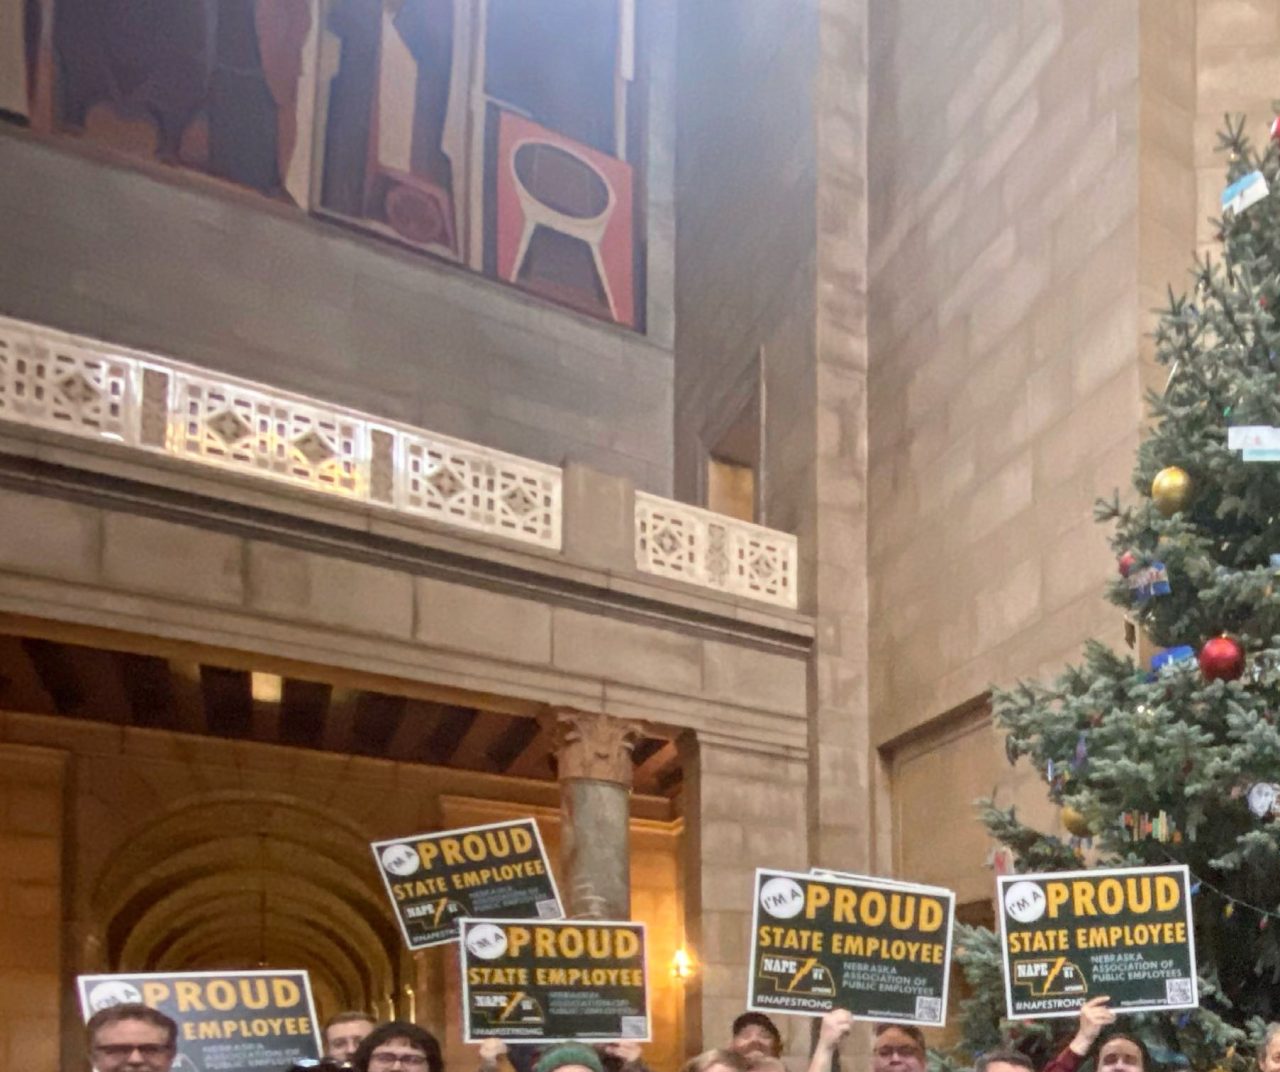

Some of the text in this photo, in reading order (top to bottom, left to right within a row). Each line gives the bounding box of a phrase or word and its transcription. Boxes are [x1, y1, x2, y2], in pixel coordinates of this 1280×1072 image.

[416, 827, 533, 870] PROUD
[393, 876, 448, 900] STATE
[451, 859, 545, 890] EMPLOYEE
[763, 888, 802, 910] I'M A
[806, 884, 943, 932] PROUD
[1008, 890, 1043, 916] I'M A
[1047, 876, 1180, 918] PROUD
[509, 927, 638, 960] PROUD
[759, 925, 944, 964] STATE EMPLOYEE
[1008, 922, 1186, 953] STATE EMPLOYEE
[469, 967, 642, 987] STATE EMPLOYEE
[763, 958, 797, 974] NAPE
[1017, 962, 1048, 977] NAPE
[143, 979, 300, 1012] PROUD
[183, 1017, 310, 1040] EMPLOYEE
